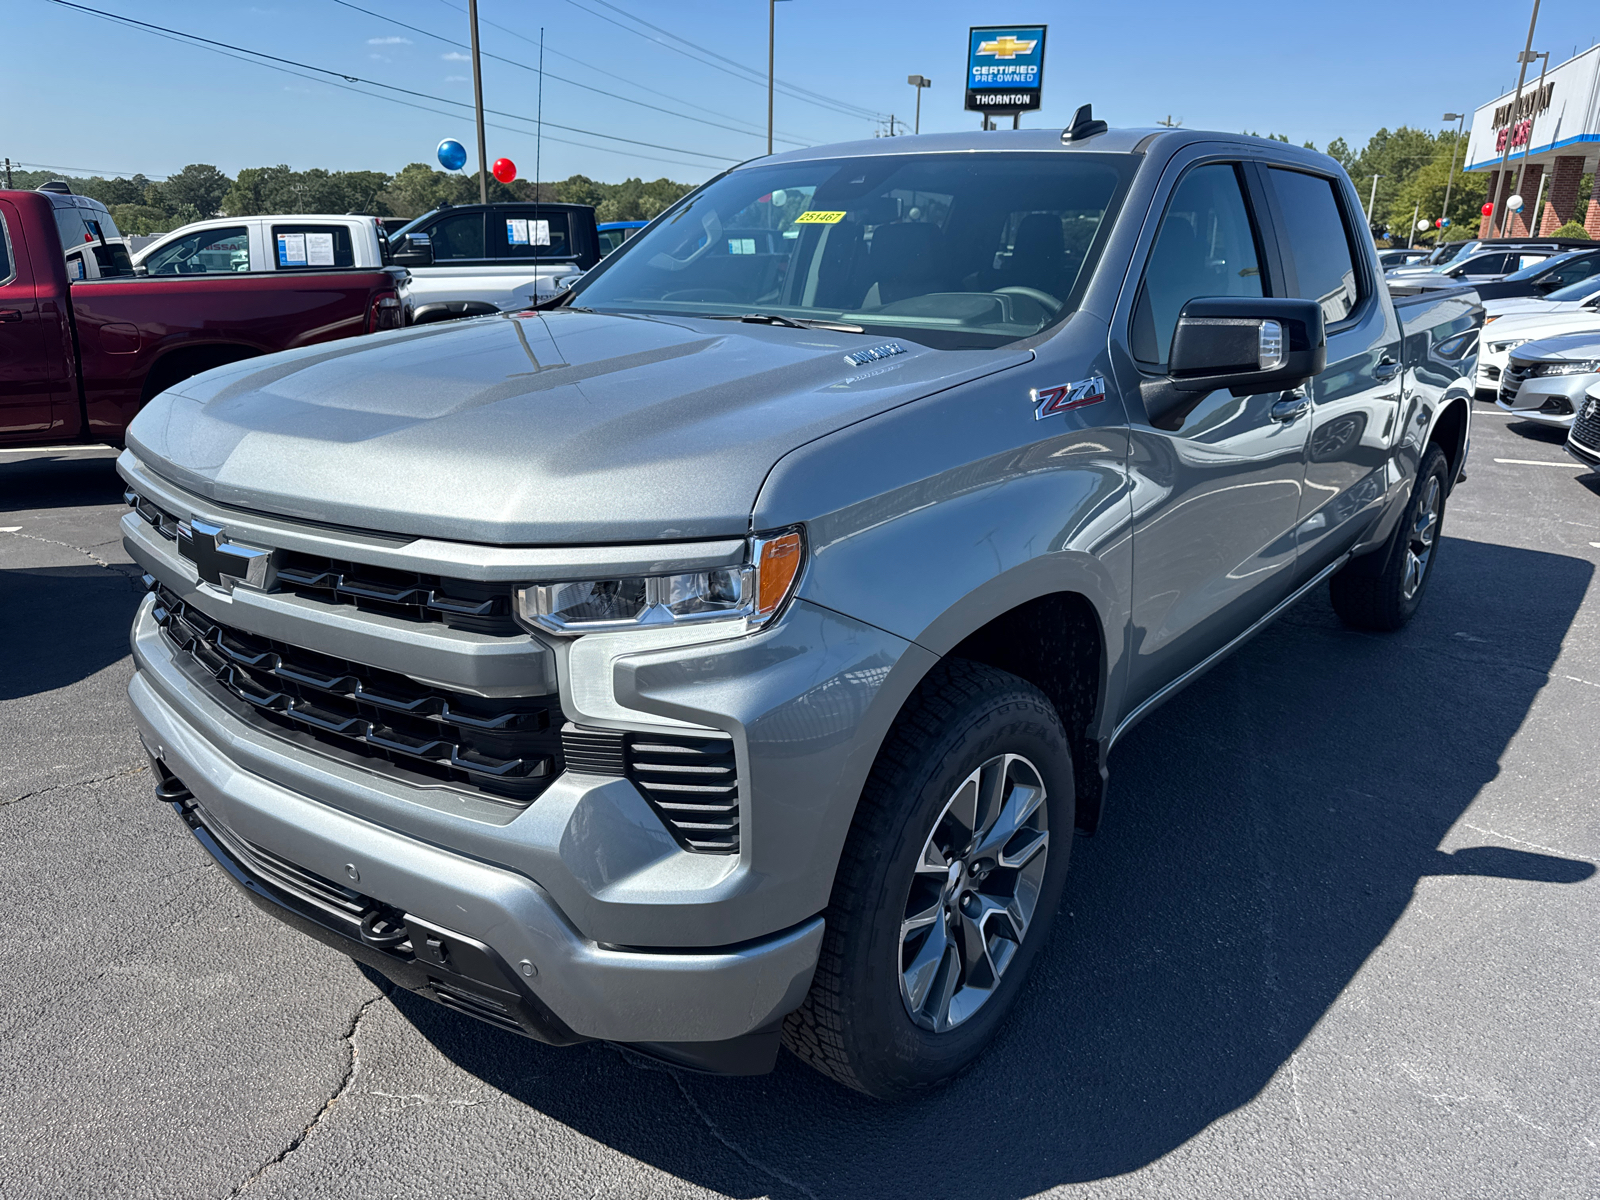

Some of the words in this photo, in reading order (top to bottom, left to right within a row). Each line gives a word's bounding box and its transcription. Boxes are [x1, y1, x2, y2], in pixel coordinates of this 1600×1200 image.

[972, 65, 1038, 75] CERTIFIED
[975, 74, 1034, 82] PRE-OWNED
[975, 94, 1031, 105] THORNTON
[799, 213, 842, 222] 251467
[1029, 376, 1106, 421] Z71
